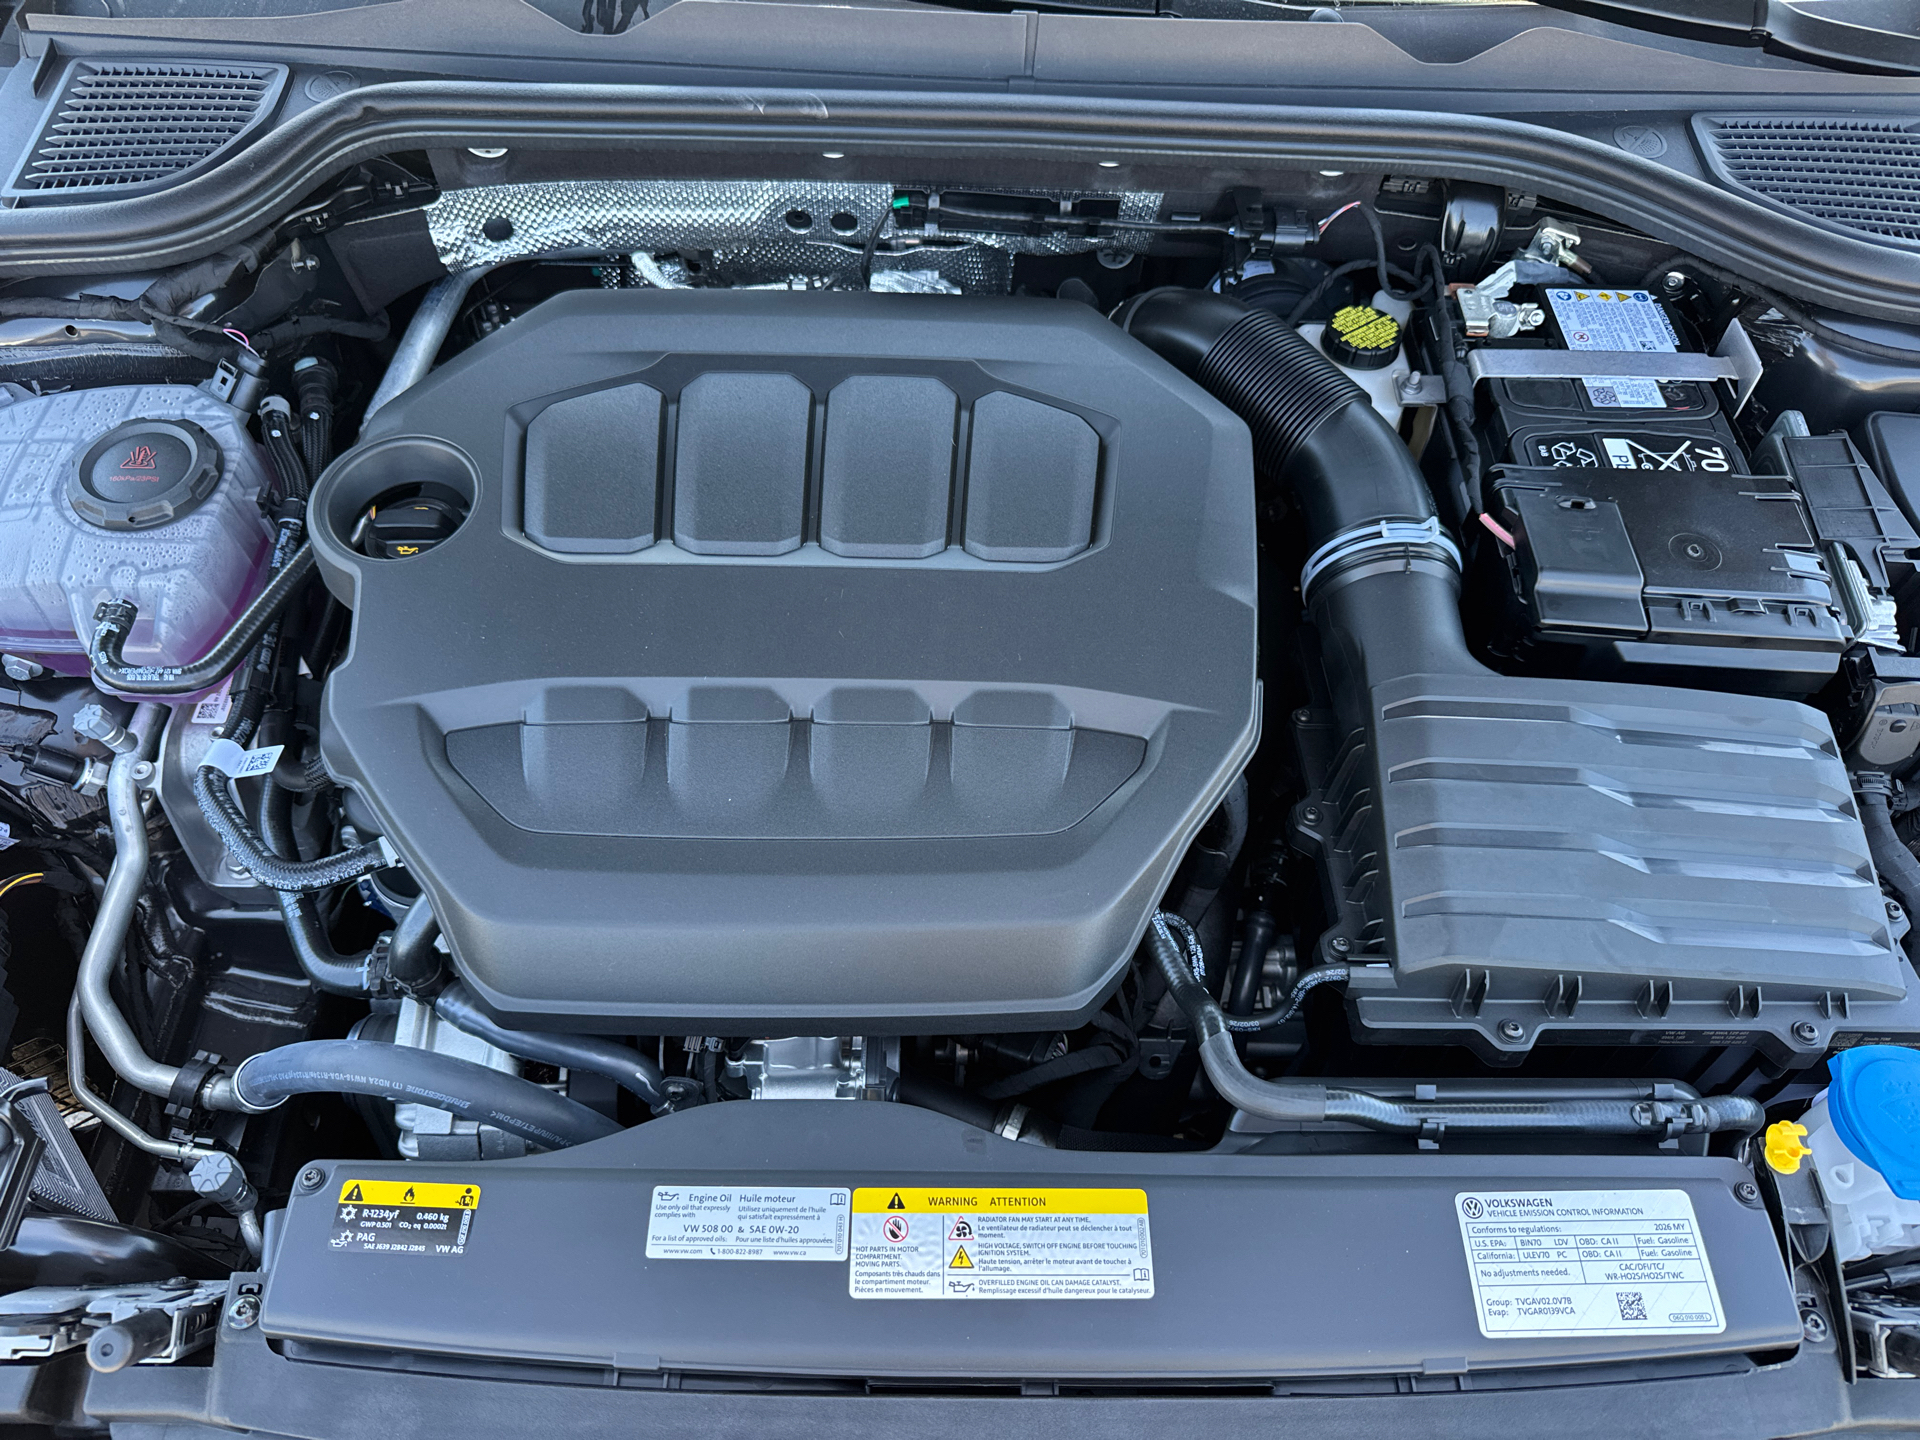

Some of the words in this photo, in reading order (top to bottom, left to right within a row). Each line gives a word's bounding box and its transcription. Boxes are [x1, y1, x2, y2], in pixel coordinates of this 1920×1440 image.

[1694, 447, 1729, 472] 70
[406, 1084, 471, 1109] BRIDGESTONE
[689, 1194, 718, 1204] Engine
[720, 1194, 732, 1202] Oil
[740, 1194, 762, 1202] Huile
[764, 1195, 795, 1203] moteur
[928, 1197, 977, 1206] WARNING
[990, 1197, 1046, 1206] ATTENTION
[1485, 1199, 1552, 1208] VOLKSWAGEN
[703, 1205, 731, 1213] expressly
[1519, 1209, 1555, 1217] EMISSION
[362, 1209, 400, 1221] R-1234yf
[440, 1213, 449, 1223] kg
[702, 1225, 718, 1233] 508
[721, 1225, 733, 1233] 00
[750, 1225, 766, 1233] SAE
[769, 1226, 799, 1234] 0W-20
[1472, 1226, 1507, 1234] Conforms
[1518, 1226, 1561, 1235] regulations:
[1654, 1223, 1672, 1231] 2026
[356, 1233, 375, 1241] PAG
[1637, 1237, 1655, 1245] Fuel:
[436, 1245, 450, 1253] VW
[451, 1246, 464, 1254] AG
[1582, 1250, 1601, 1258] OBD:
[1604, 1250, 1615, 1258] CA
[1640, 1249, 1658, 1257] Fuel:
[1477, 1252, 1518, 1260] California:
[1523, 1251, 1550, 1259] ULEV70
[1619, 1263, 1664, 1271] CAC/DFI/TC/
[1494, 1269, 1539, 1279] adjustments
[1541, 1268, 1570, 1276] needed.
[979, 1287, 1016, 1295] Remplissage
[1486, 1299, 1512, 1308] Group:
[1515, 1297, 1572, 1305] TVGAV02.0V7B
[1488, 1308, 1508, 1317] Evap:
[1517, 1307, 1575, 1315] TVGAR0139VCA
